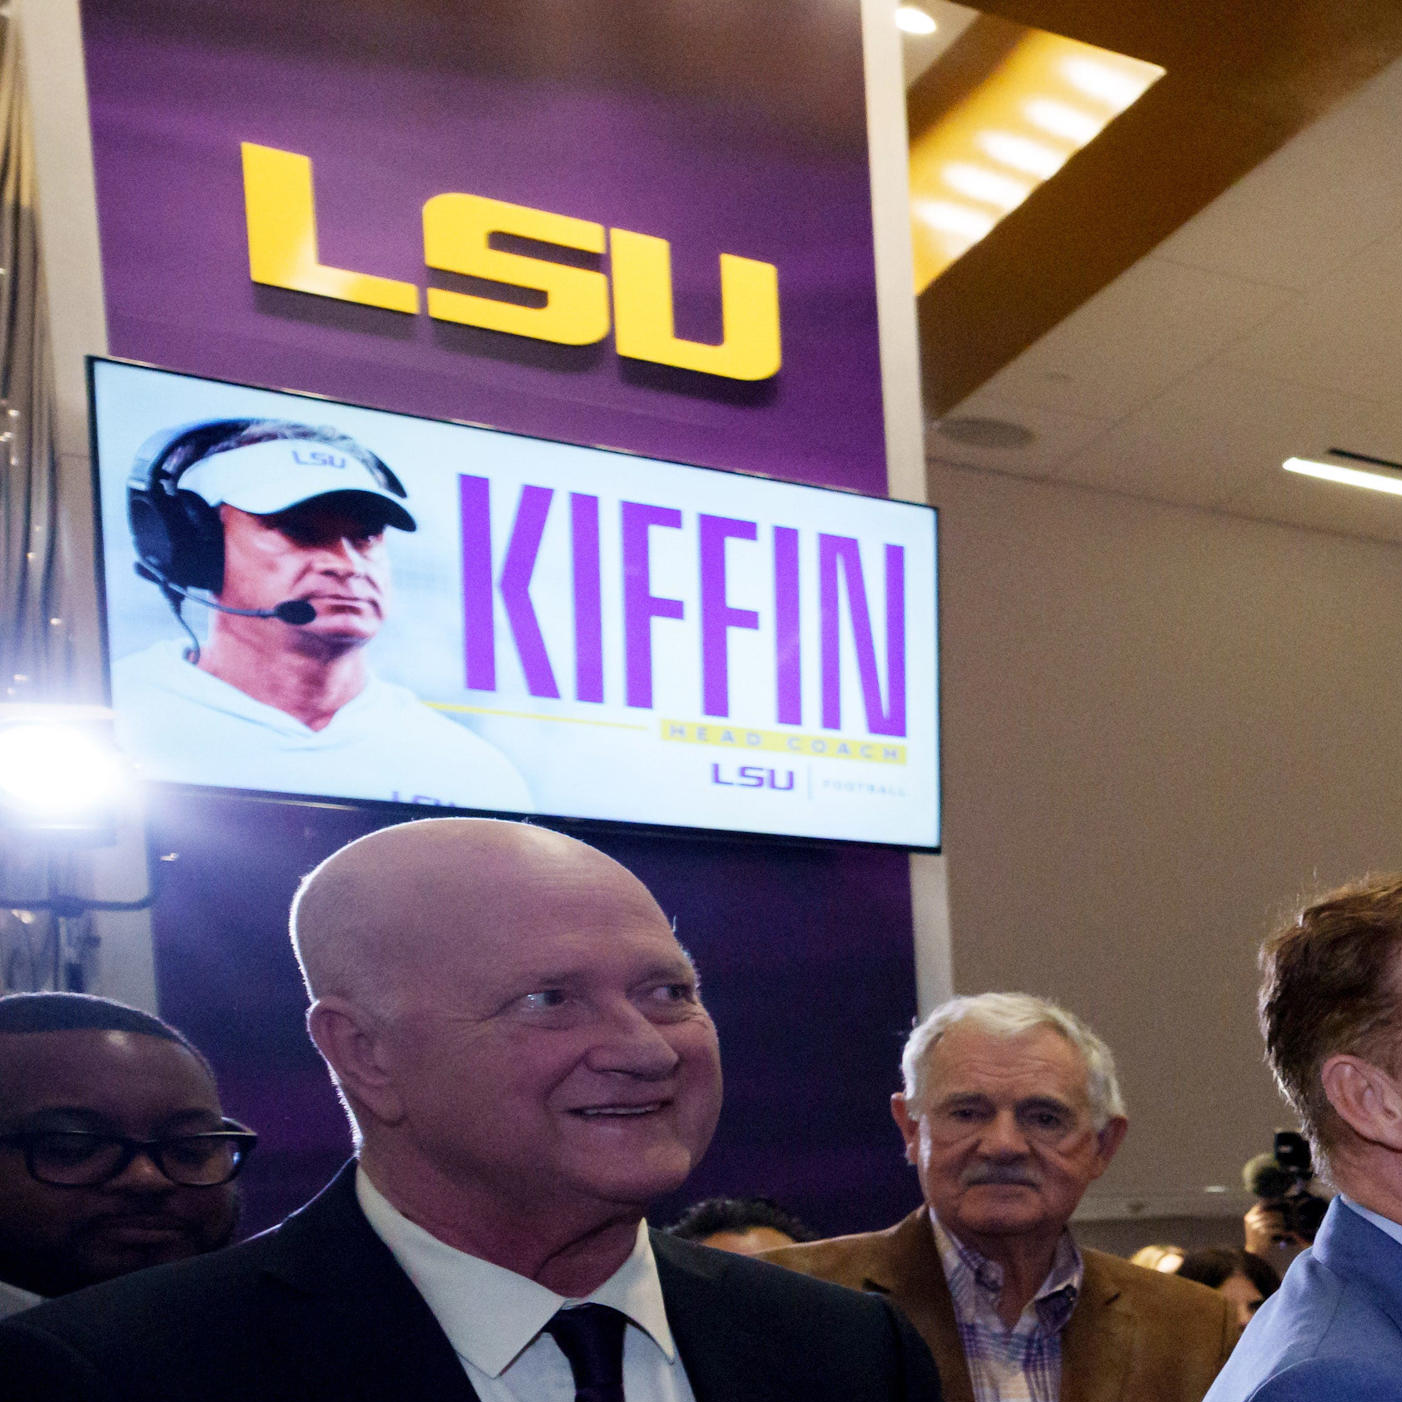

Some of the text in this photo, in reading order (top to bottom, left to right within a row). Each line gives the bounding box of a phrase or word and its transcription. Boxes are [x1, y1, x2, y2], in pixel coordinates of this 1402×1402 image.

[241, 142, 782, 381] LSU
[291, 450, 347, 469] LSU
[458, 473, 907, 738] KIFFIN
[668, 723, 900, 761] HEAD COACH
[711, 762, 795, 791] LSU
